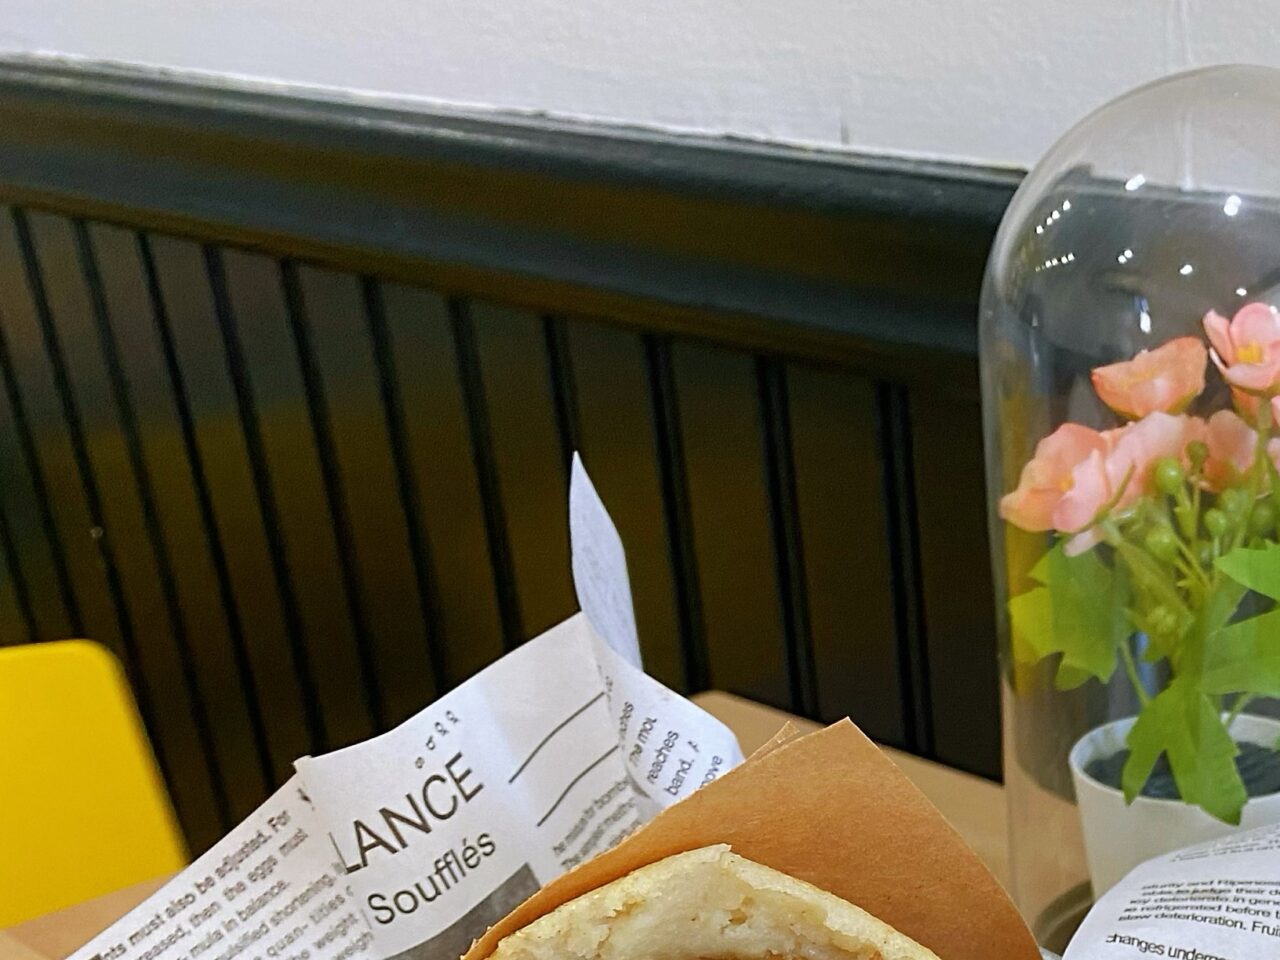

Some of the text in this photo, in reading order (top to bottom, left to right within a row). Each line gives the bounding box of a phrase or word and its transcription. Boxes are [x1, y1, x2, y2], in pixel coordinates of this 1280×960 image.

[647, 730, 679, 785] reaches
[164, 892, 197, 920] also
[195, 875, 216, 895] be
[367, 832, 496, 925] Soufflés
